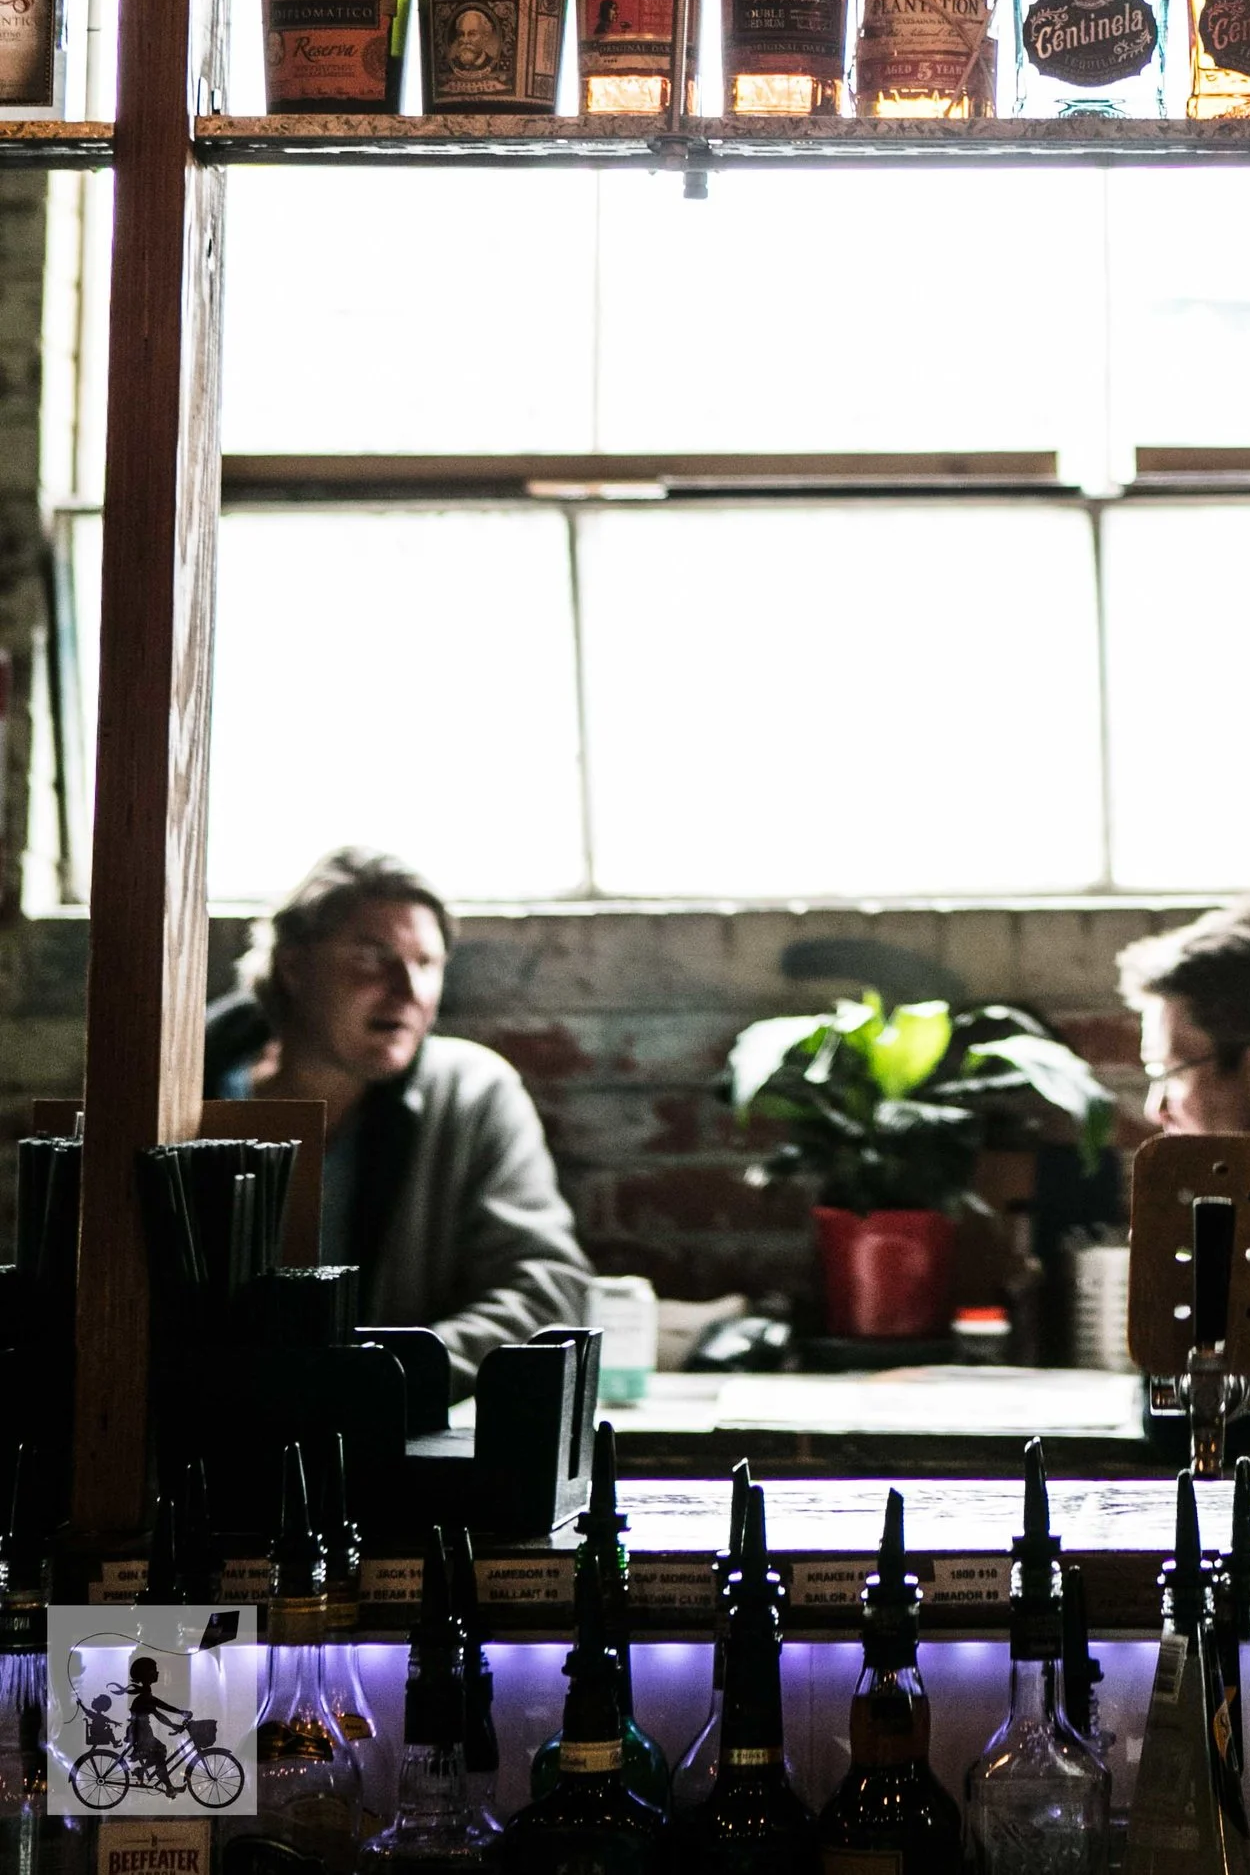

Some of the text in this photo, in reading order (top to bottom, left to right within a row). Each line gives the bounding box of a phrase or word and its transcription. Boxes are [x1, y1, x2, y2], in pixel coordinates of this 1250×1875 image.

[1034, 3, 1144, 61] Centinela
[292, 36, 359, 63] Reserva
[885, 64, 912, 75] AGED
[916, 61, 933, 81] 5
[375, 1568, 405, 1580] JACK
[634, 1572, 712, 1584] CAP MORGAN
[807, 1570, 855, 1582] KRAKEN
[373, 1589, 406, 1601] BEAM
[804, 1591, 848, 1604] SAILOR
[933, 1590, 983, 1602] JIMADOR
[109, 1848, 200, 1874] BEEFEATER
